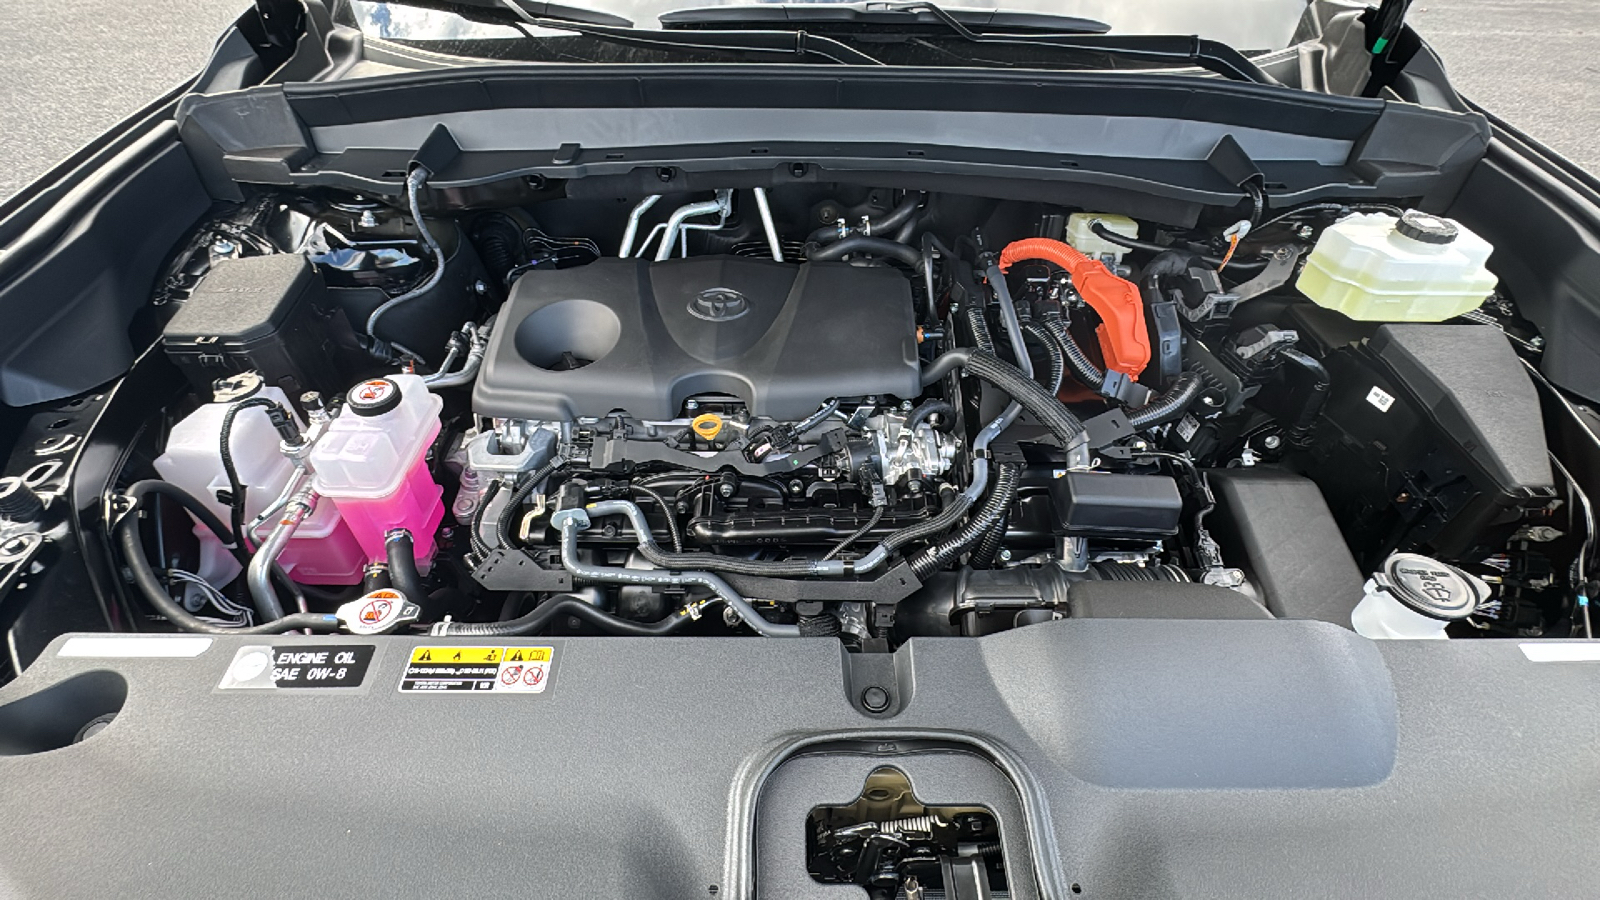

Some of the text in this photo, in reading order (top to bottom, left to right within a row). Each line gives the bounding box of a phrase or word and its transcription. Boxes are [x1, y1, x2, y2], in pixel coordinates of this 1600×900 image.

[276, 652, 356, 664] ENGINE OIL
[270, 668, 347, 680] SAE 0W-8
